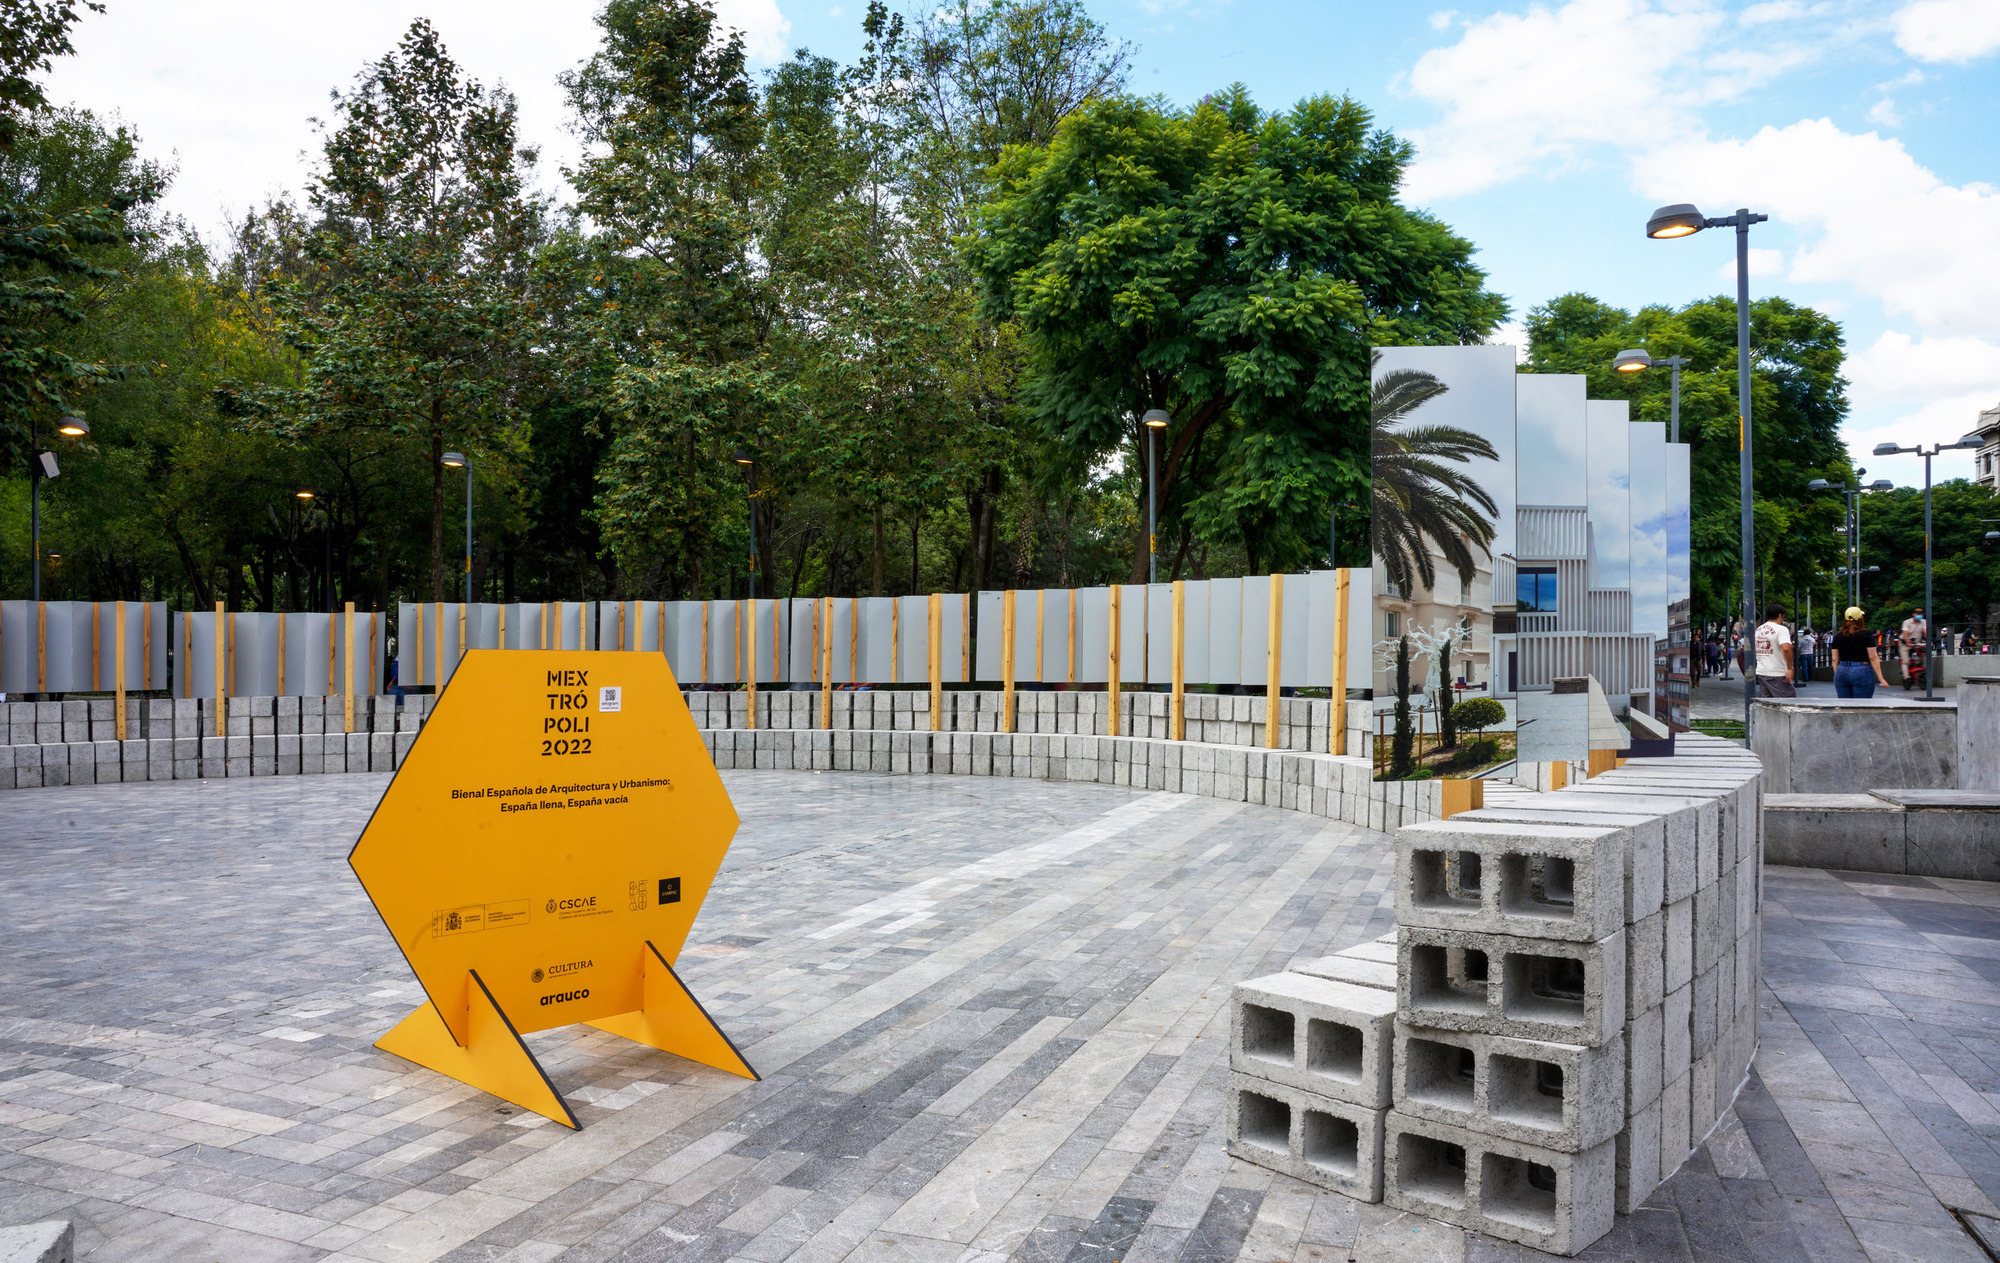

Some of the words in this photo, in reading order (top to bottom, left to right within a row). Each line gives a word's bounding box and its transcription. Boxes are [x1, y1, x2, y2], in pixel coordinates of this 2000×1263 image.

[547, 670, 589, 687] MEX
[547, 689, 588, 710] TRÓ
[544, 717, 590, 734] POLI
[541, 738, 592, 756] 2022
[451, 788, 485, 799] Bienal
[486, 786, 533, 799] Española
[535, 785, 548, 794] de
[549, 783, 610, 794] Arquitectura
[612, 782, 618, 791] y
[619, 778, 671, 789] Urbanismo:
[500, 801, 538, 813] España
[539, 800, 566, 809] llena,
[567, 797, 602, 808] España
[604, 795, 629, 804] vacía
[548, 959, 594, 975] CULTURA
[540, 989, 590, 1006] arauco
